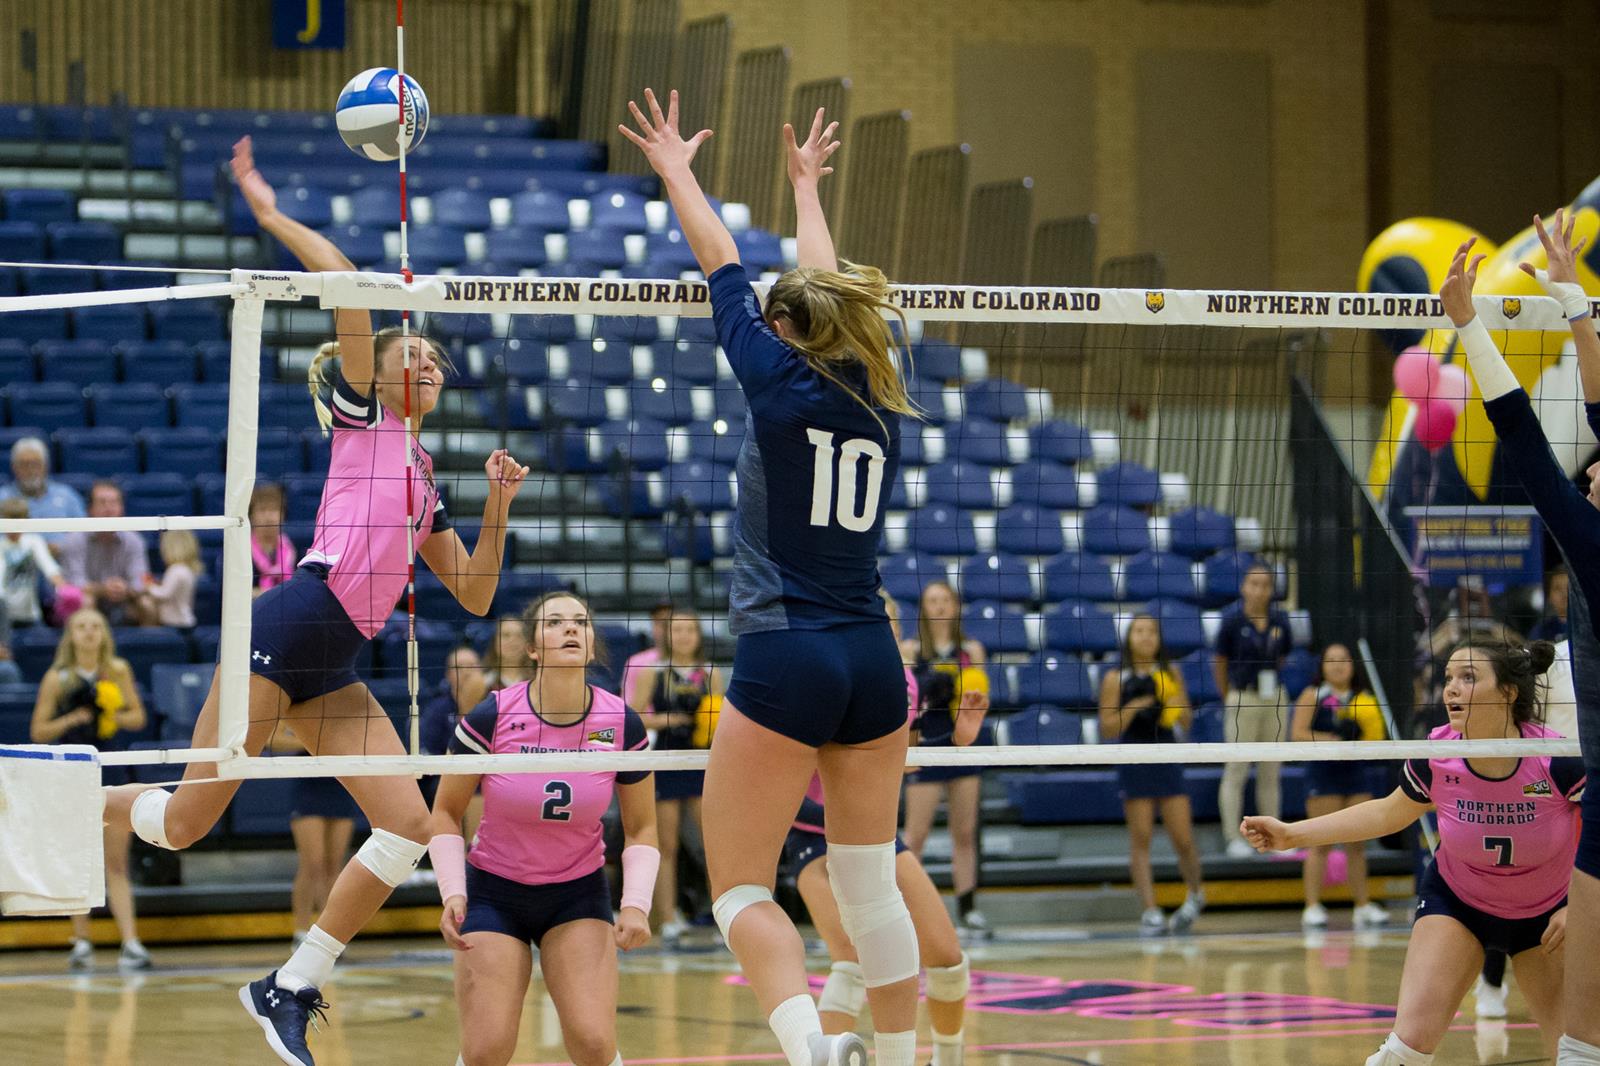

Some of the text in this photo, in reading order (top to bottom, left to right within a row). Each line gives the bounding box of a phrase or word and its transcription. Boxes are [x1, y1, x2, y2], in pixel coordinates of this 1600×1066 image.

[444, 281, 709, 303] NORTHERN COLORAD
[885, 290, 1101, 311] THERN COLORADO
[1207, 294, 1445, 318] NORTHERN COLORAD
[806, 427, 886, 533] 10
[520, 745, 597, 753] NORT
[541, 780, 573, 822] 2
[1456, 799, 1536, 813] NORTHERN
[1458, 811, 1536, 825] COLORADO
[1483, 835, 1517, 867] 7
